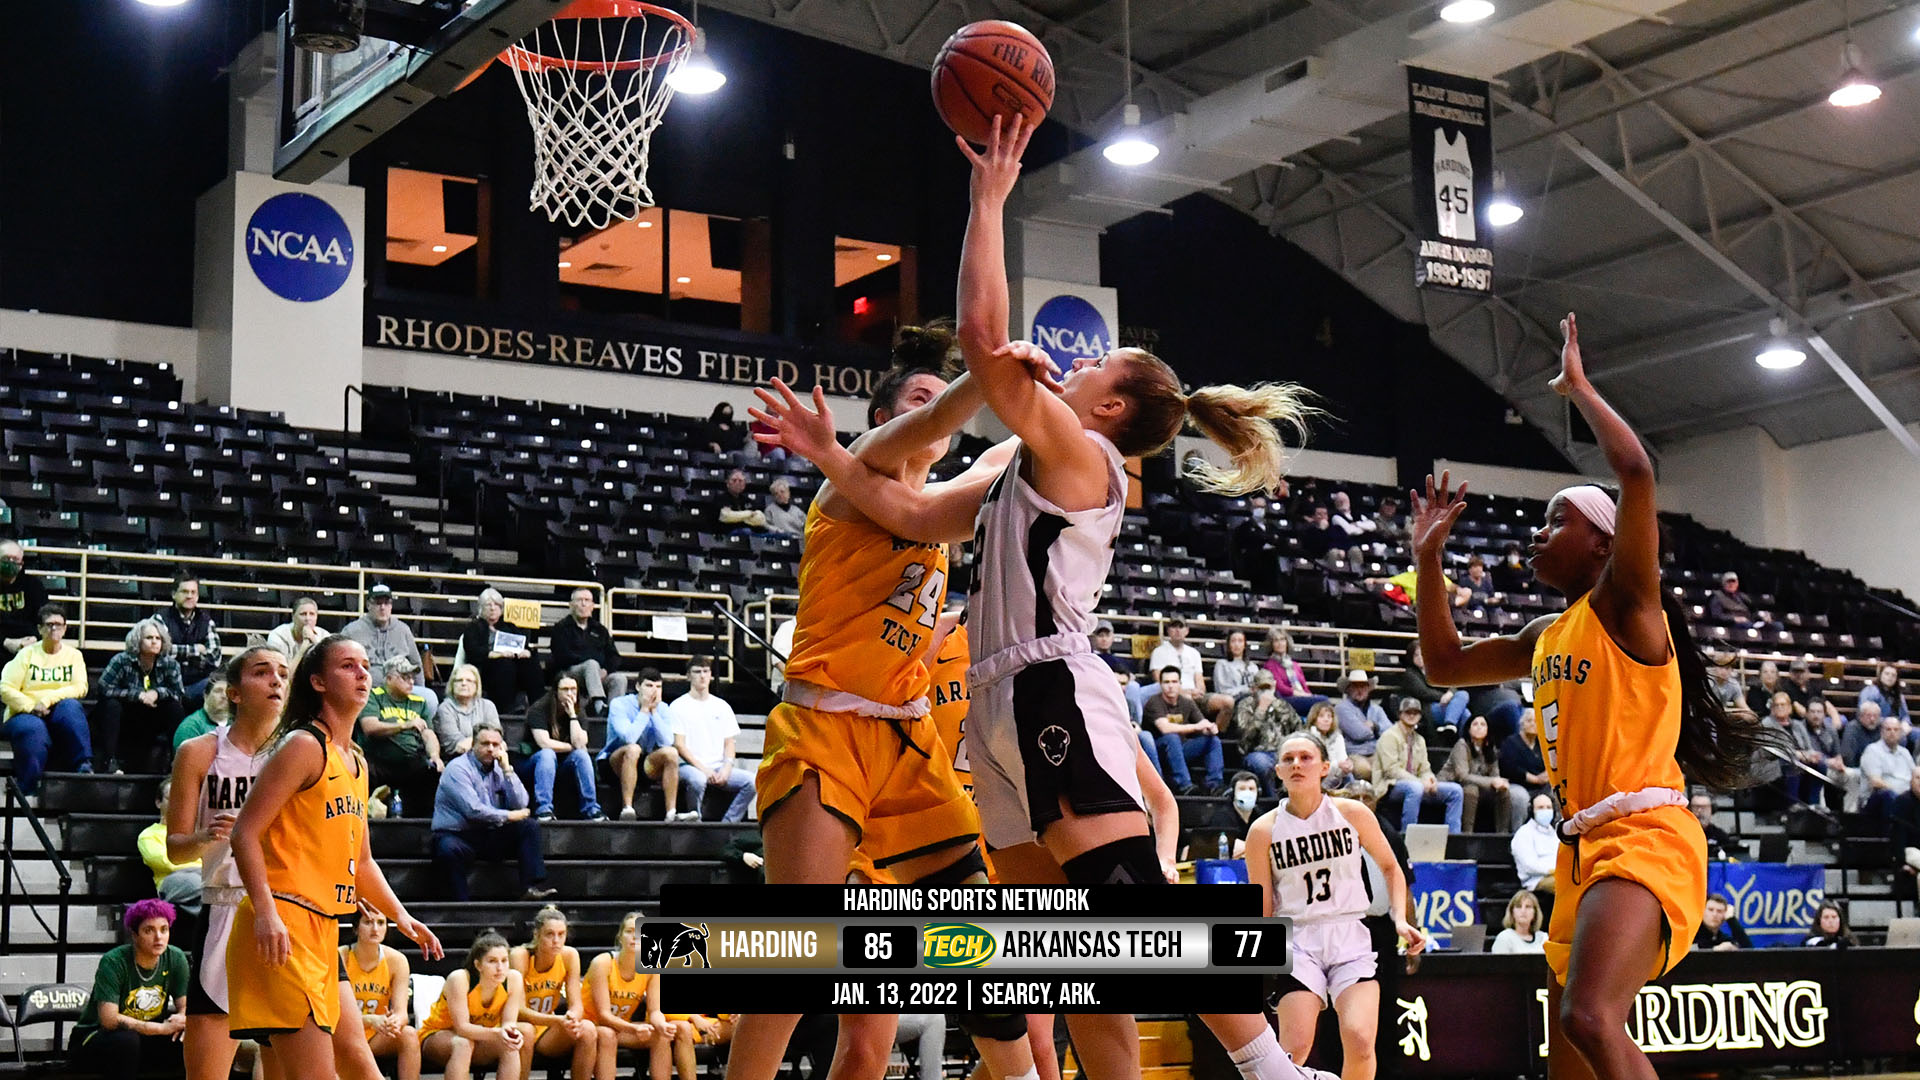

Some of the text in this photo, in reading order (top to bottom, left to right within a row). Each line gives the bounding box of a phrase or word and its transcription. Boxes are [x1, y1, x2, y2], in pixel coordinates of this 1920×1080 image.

[992, 43, 1029, 71] THE
[1439, 184, 1468, 214] 45
[252, 227, 347, 266] NCAA
[376, 315, 683, 376] RHODES-REAVES
[698, 350, 799, 387] FIELD
[1034, 324, 1107, 357] NCAA
[505, 606, 539, 622] VISITOR
[885, 562, 945, 631] 24
[29, 663, 73, 682] TECH
[207, 774, 256, 809] HAR
[1271, 827, 1353, 870] HARDING
[1303, 868, 1331, 905] 13
[1725, 874, 1825, 927] YOURS
[50, 989, 87, 1005] Unity
[1537, 980, 1829, 1057] RDING
